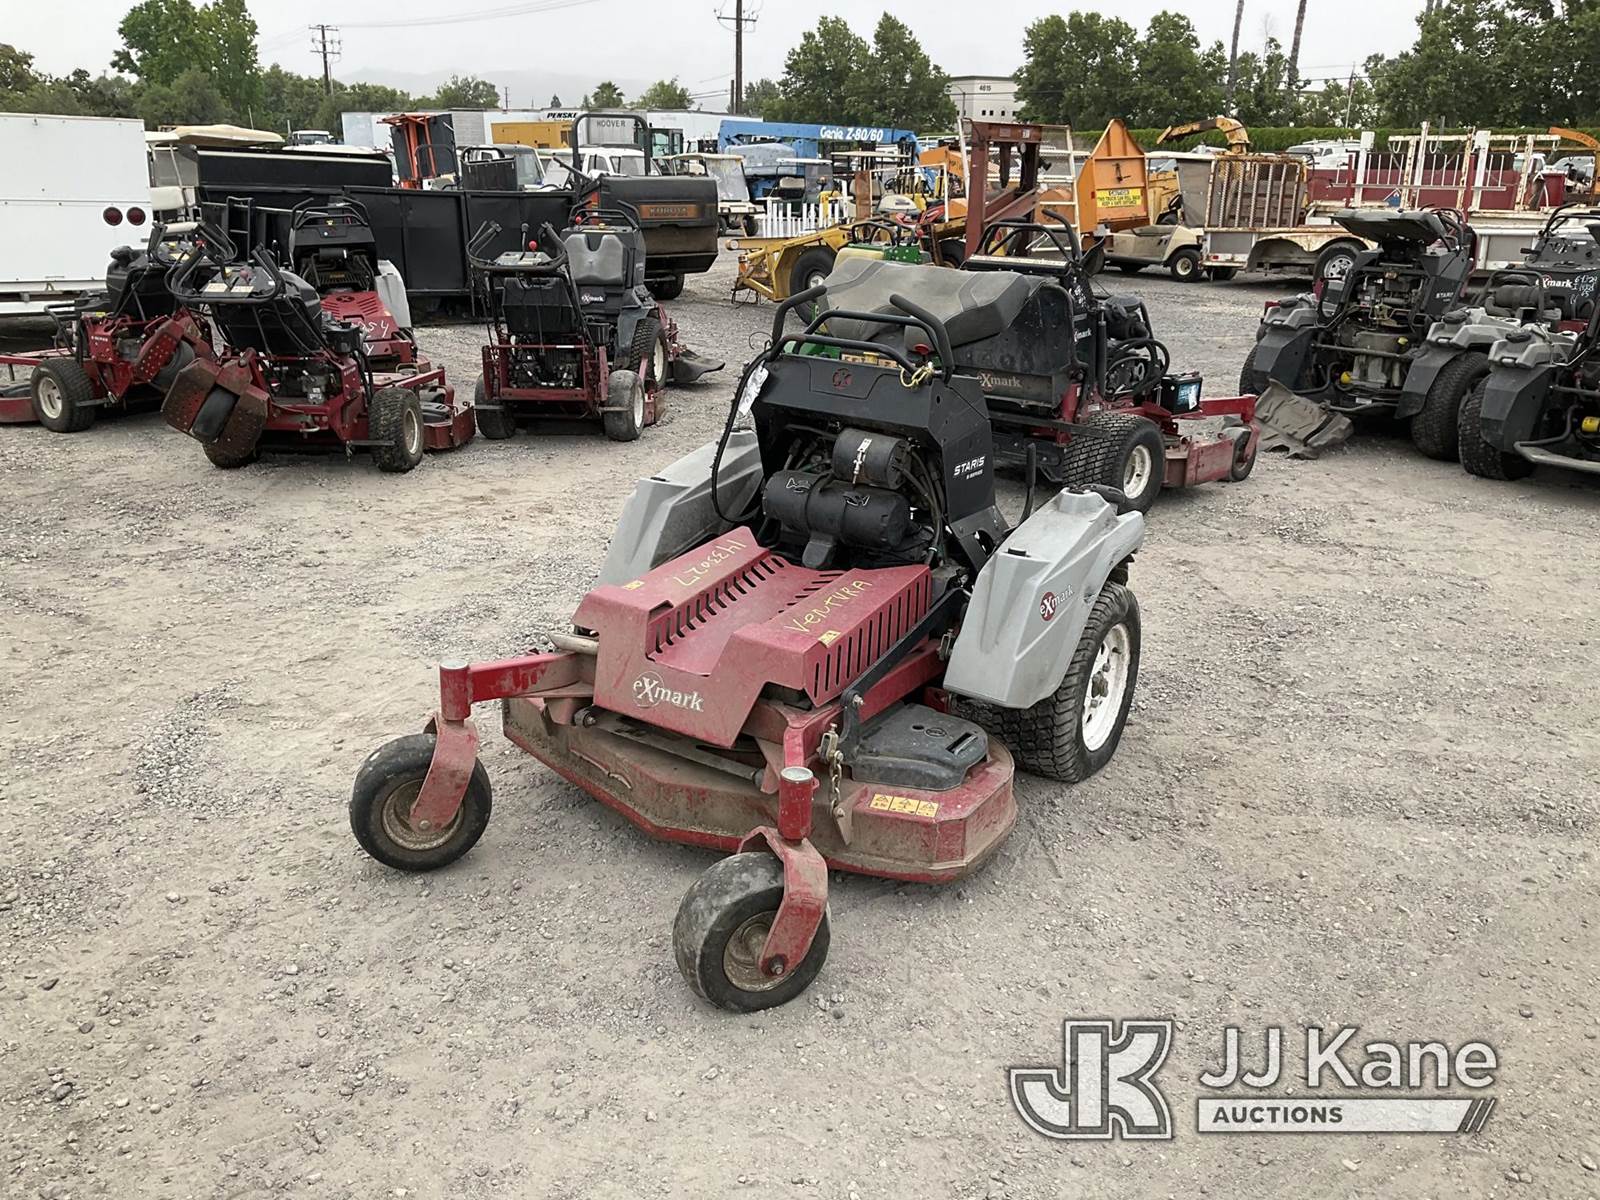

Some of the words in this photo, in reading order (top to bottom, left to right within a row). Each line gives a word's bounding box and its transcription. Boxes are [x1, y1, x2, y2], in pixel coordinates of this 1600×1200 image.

[820, 126, 844, 139] Genie
[953, 455, 986, 476] STARIS
[632, 674, 704, 712] eXmark
